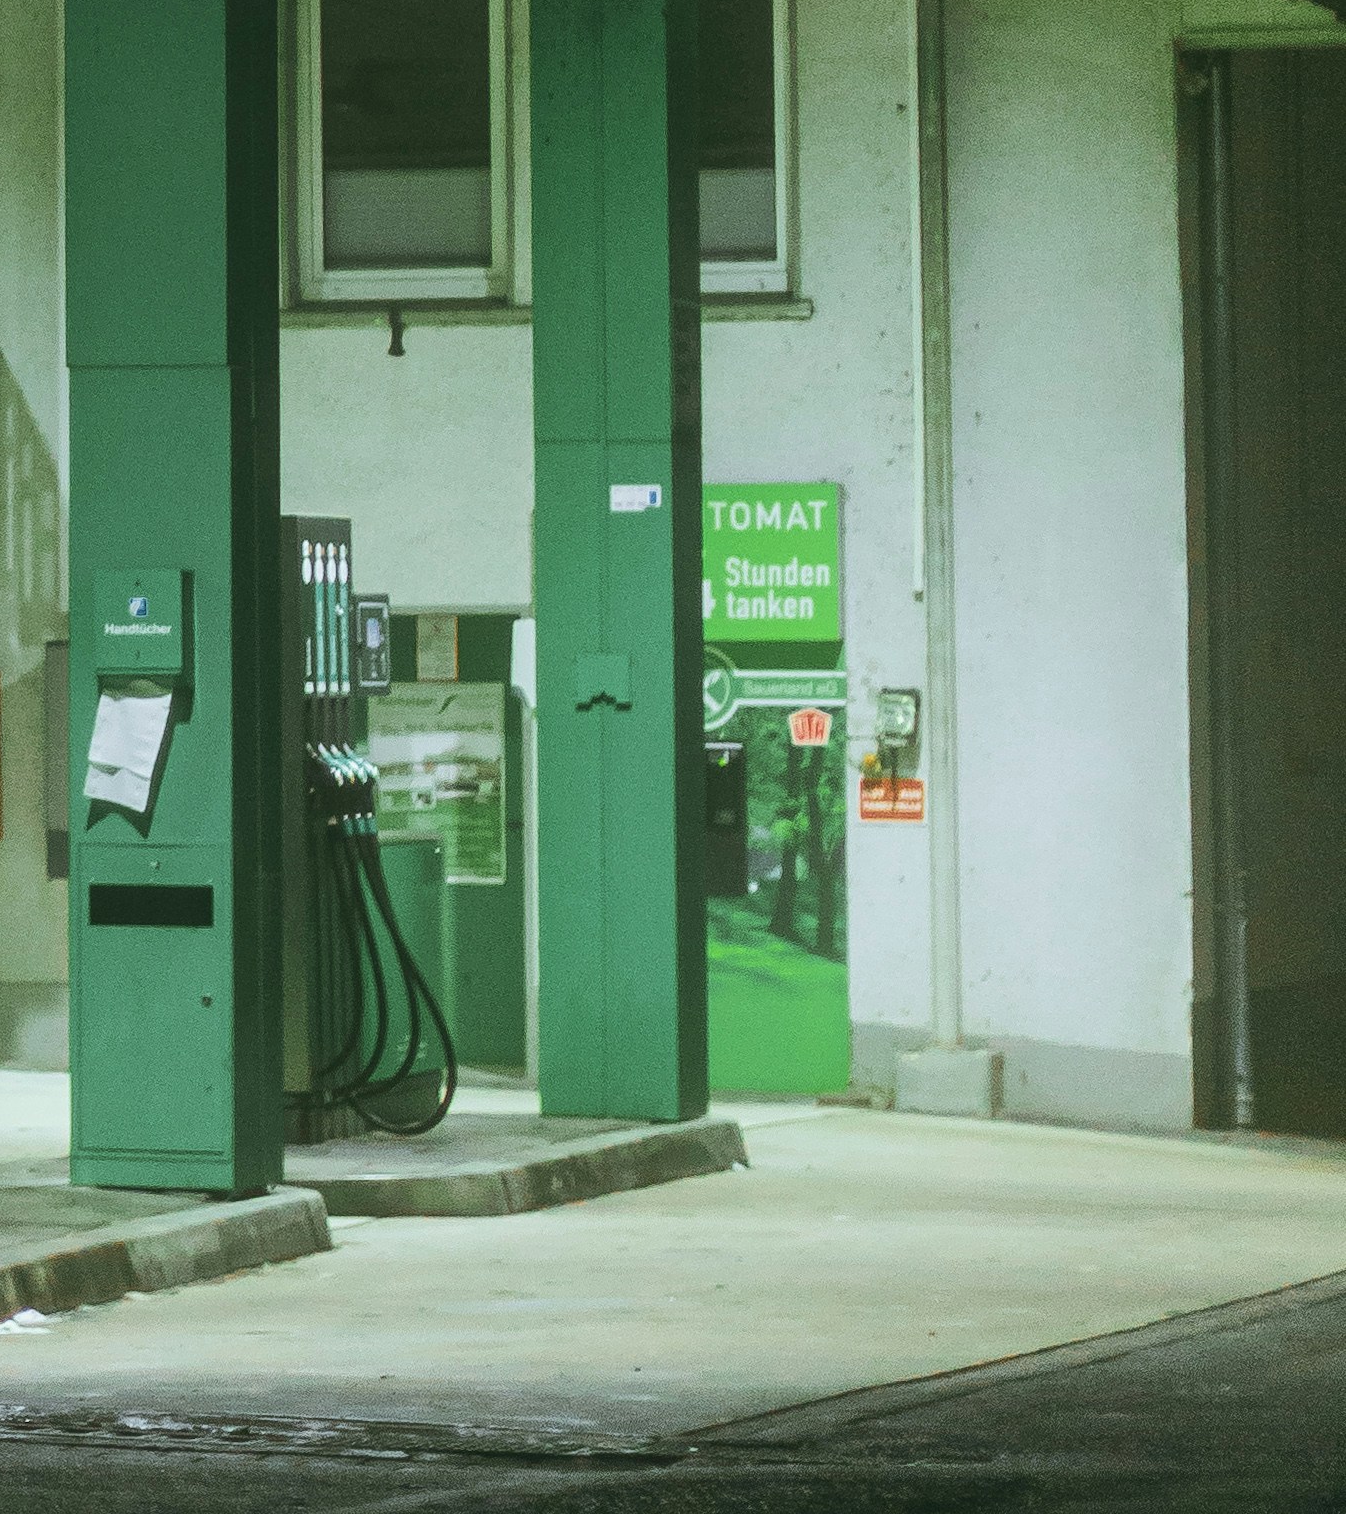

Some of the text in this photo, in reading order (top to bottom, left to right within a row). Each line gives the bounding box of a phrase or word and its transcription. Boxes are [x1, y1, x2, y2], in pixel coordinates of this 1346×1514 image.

[709, 500, 828, 531] TOMAT
[725, 556, 831, 588] Stunden
[726, 589, 815, 620] tanken
[104, 623, 172, 636] Handtücher
[793, 712, 827, 741] UTA
